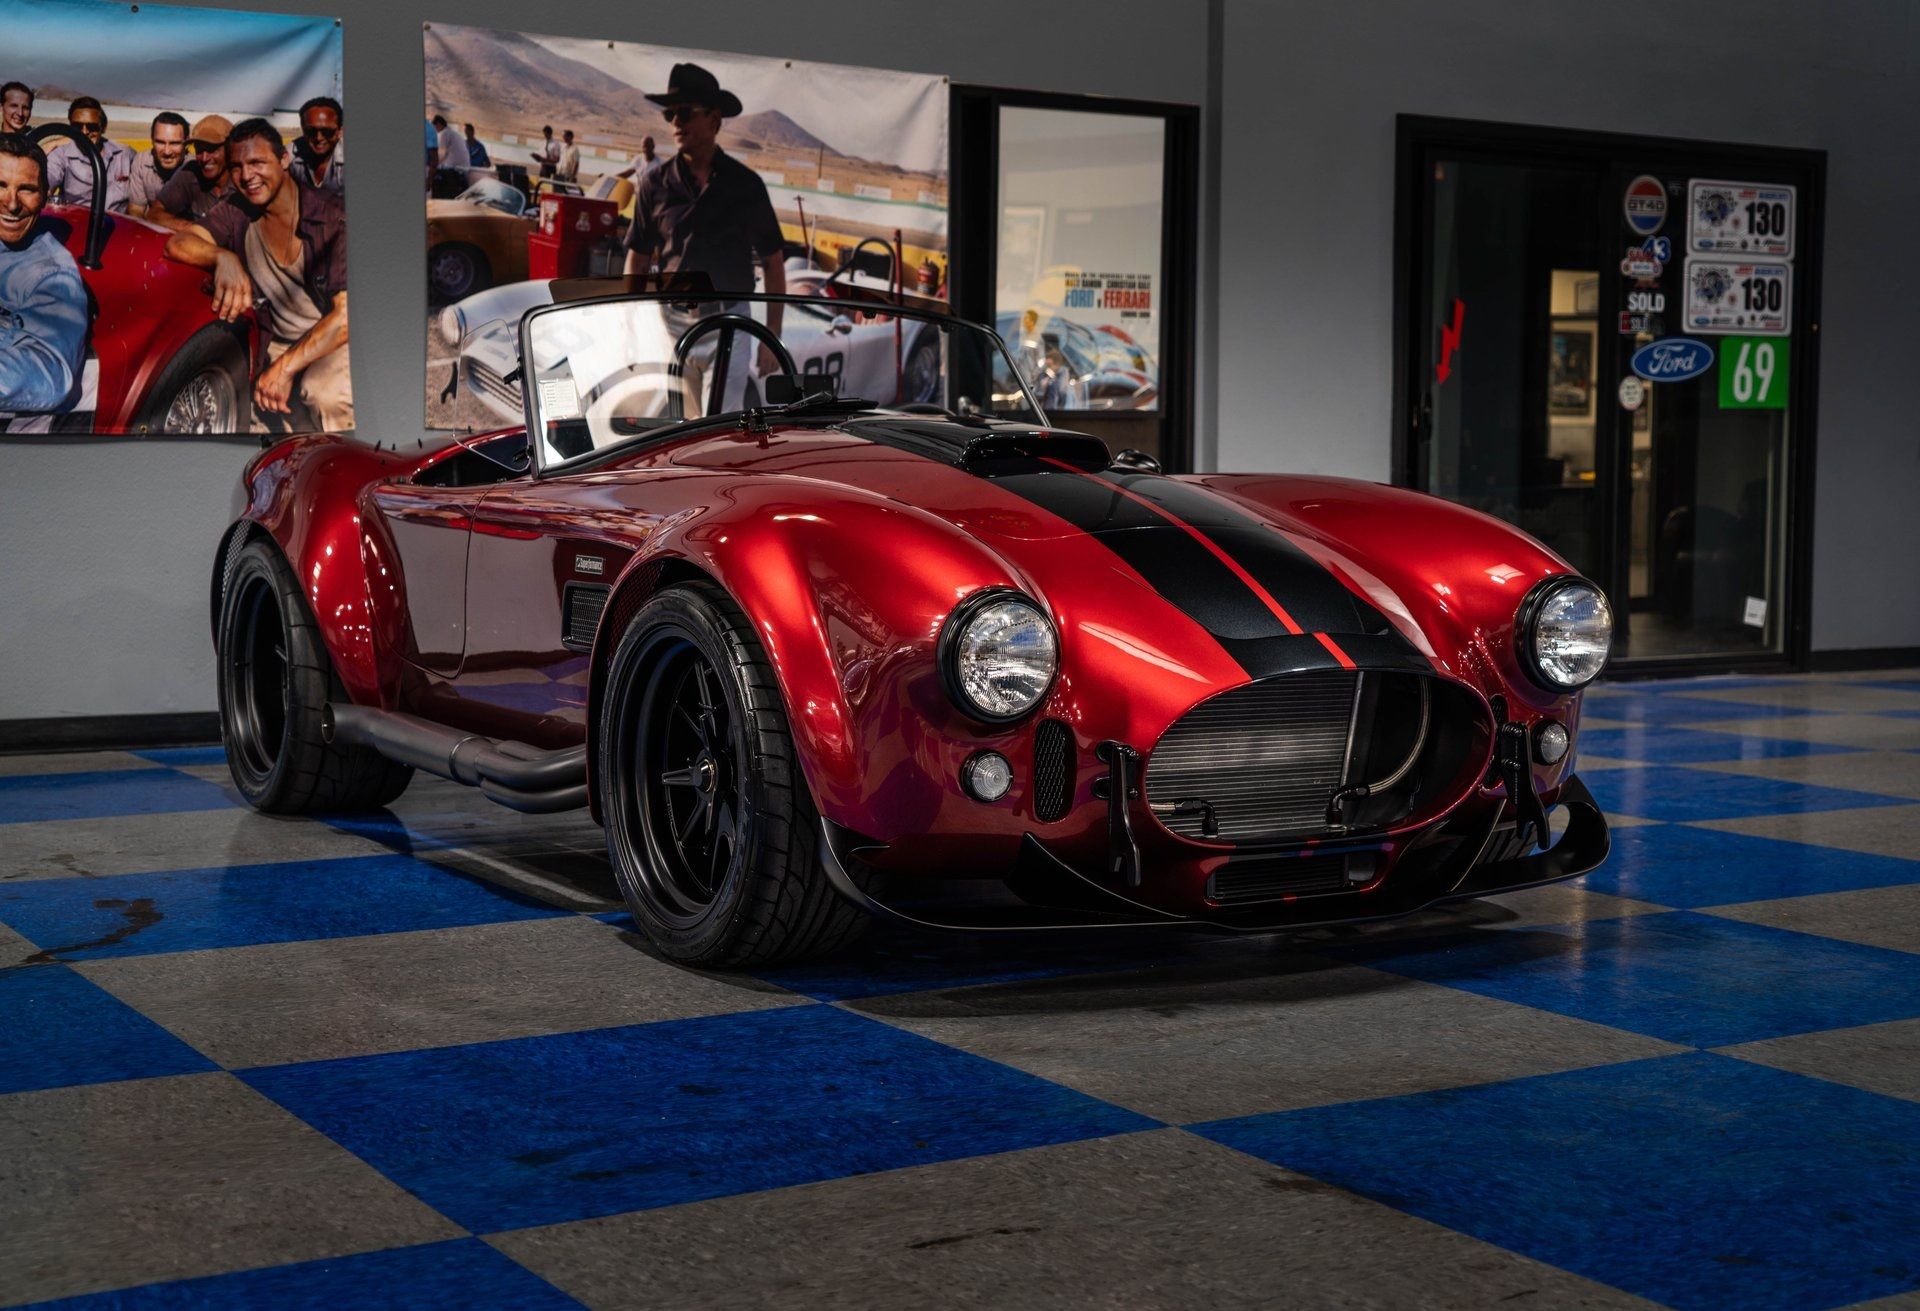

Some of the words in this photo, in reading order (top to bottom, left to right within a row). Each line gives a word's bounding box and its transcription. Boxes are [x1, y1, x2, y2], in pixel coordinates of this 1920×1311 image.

[1745, 201, 1785, 236] 130
[1065, 289, 1094, 308] FORD
[1104, 290, 1151, 309] FERRARI
[1628, 292, 1665, 313] SOLD
[1741, 277, 1782, 312] 130
[1649, 344, 1696, 375] Ford
[1733, 341, 1775, 403] 69
